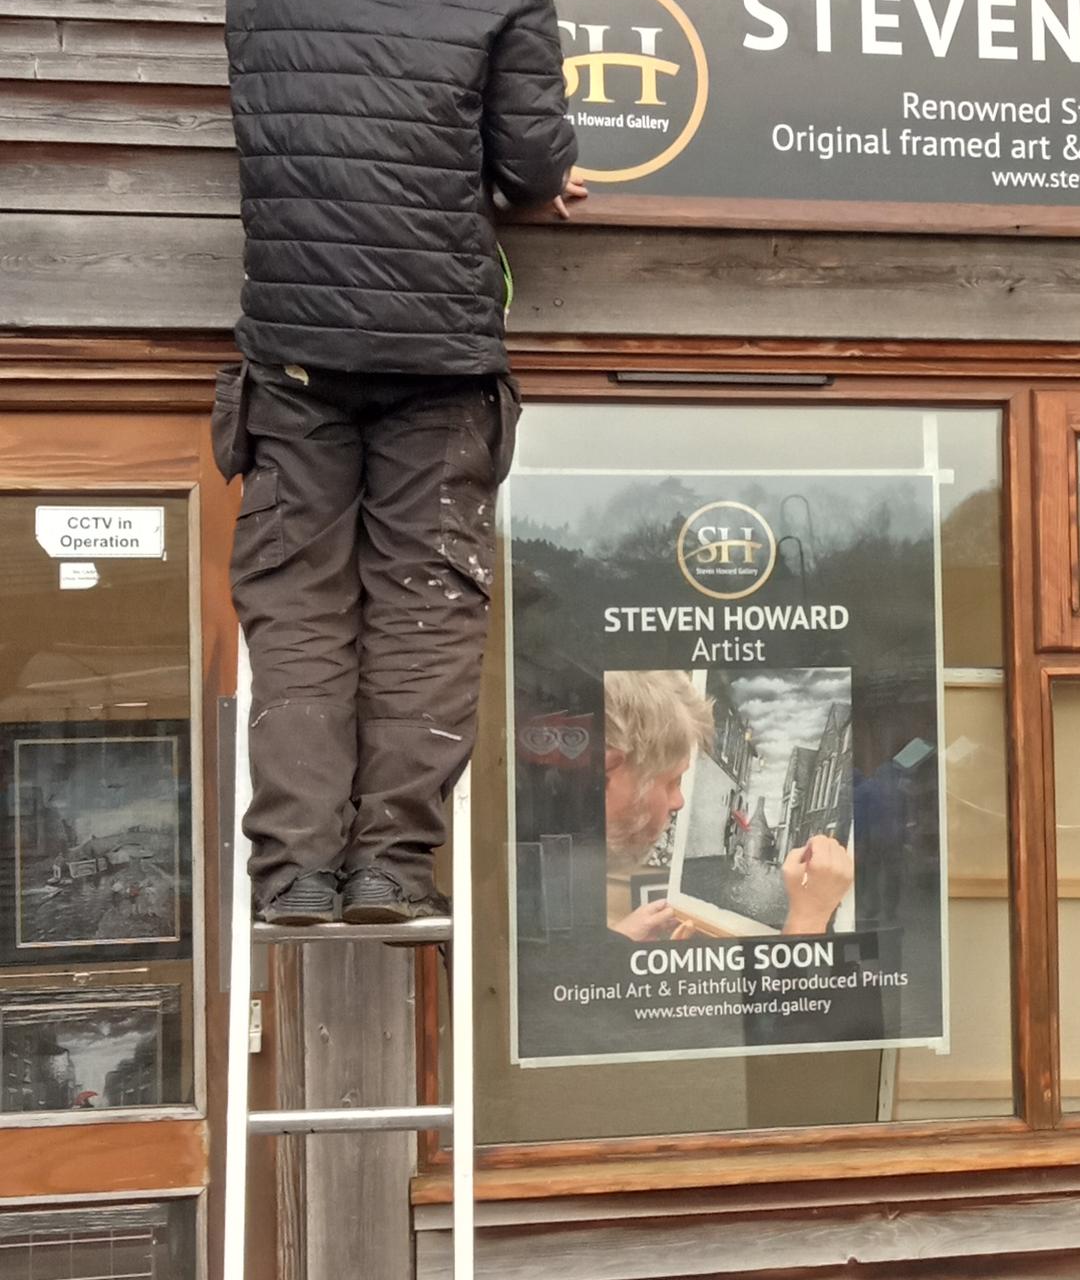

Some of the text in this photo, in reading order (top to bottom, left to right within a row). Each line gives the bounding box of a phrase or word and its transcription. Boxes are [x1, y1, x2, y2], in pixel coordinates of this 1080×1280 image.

[903, 91, 1050, 124] Renowned
[577, 111, 624, 128] Howard
[626, 114, 670, 133] Gallery
[772, 123, 890, 160] Original
[899, 129, 1001, 158] framed
[1010, 136, 1051, 161] art
[67, 516, 133, 530] CCTV in
[60, 534, 140, 551] Operation
[604, 605, 849, 633] STEVEN HOWARD
[691, 636, 766, 662] Artist
[630, 941, 834, 976] COMING SOON
[553, 970, 908, 1005] Original Art & Faithfully Reproduced Prints
[634, 997, 832, 1020] www.stevenhoward.gallery
